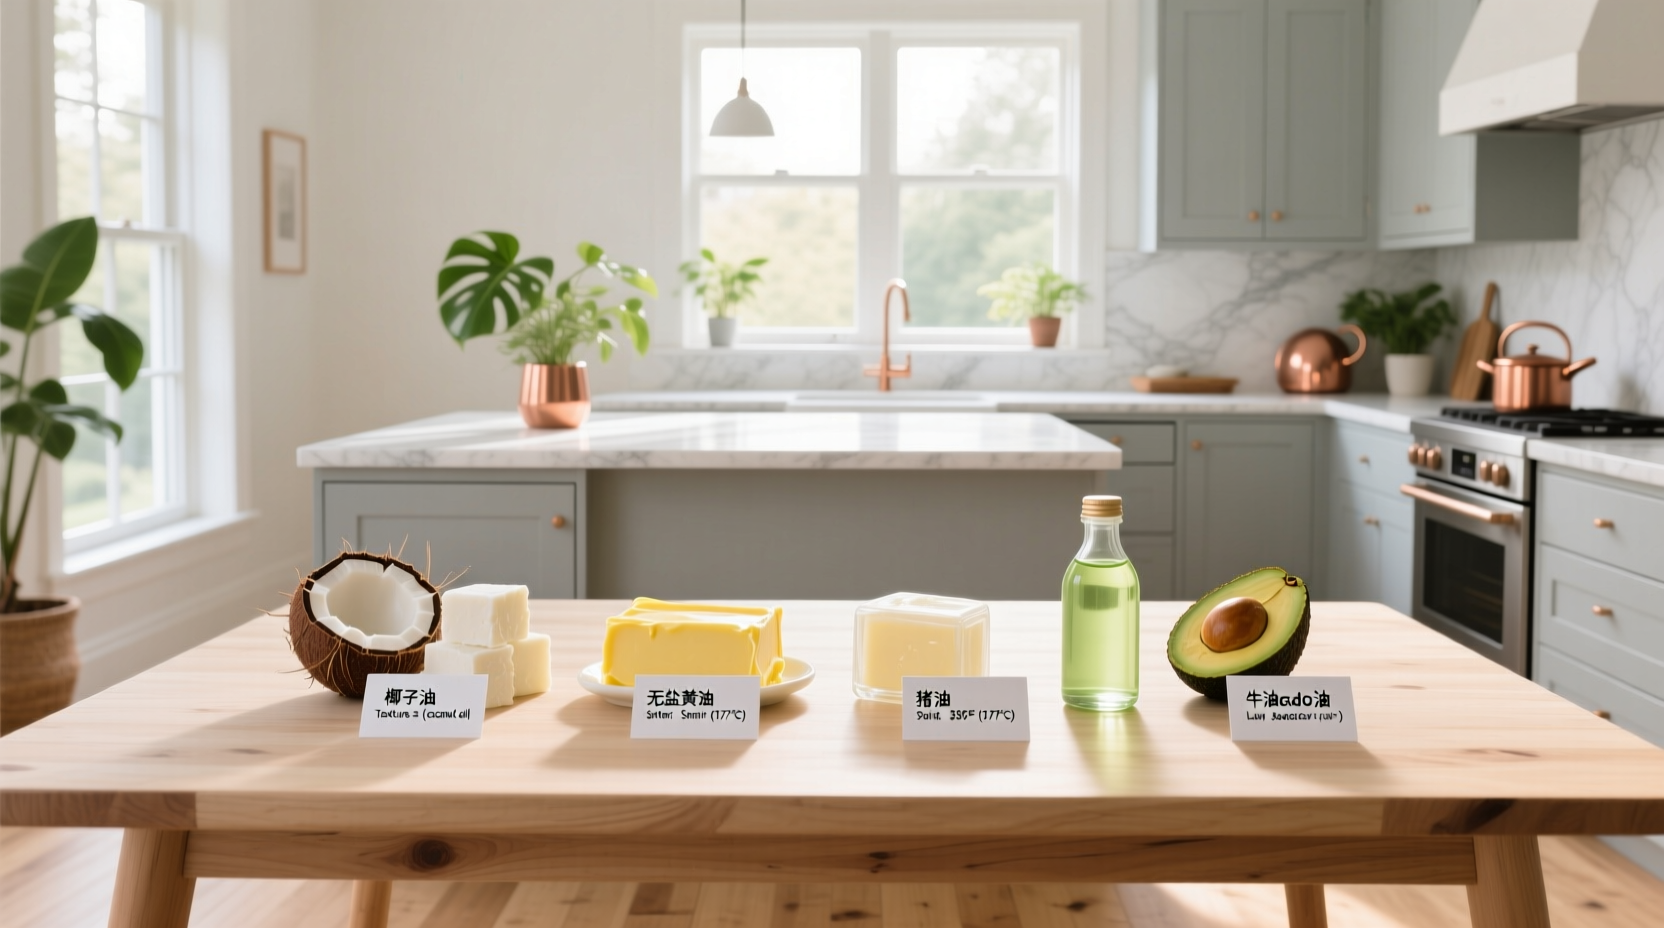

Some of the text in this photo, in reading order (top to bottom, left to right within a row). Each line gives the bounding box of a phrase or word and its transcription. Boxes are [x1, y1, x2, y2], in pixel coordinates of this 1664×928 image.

[384, 687, 436, 706] 椰子油
[646, 688, 714, 706] 无盐黄油
[915, 689, 951, 708] 猪油
